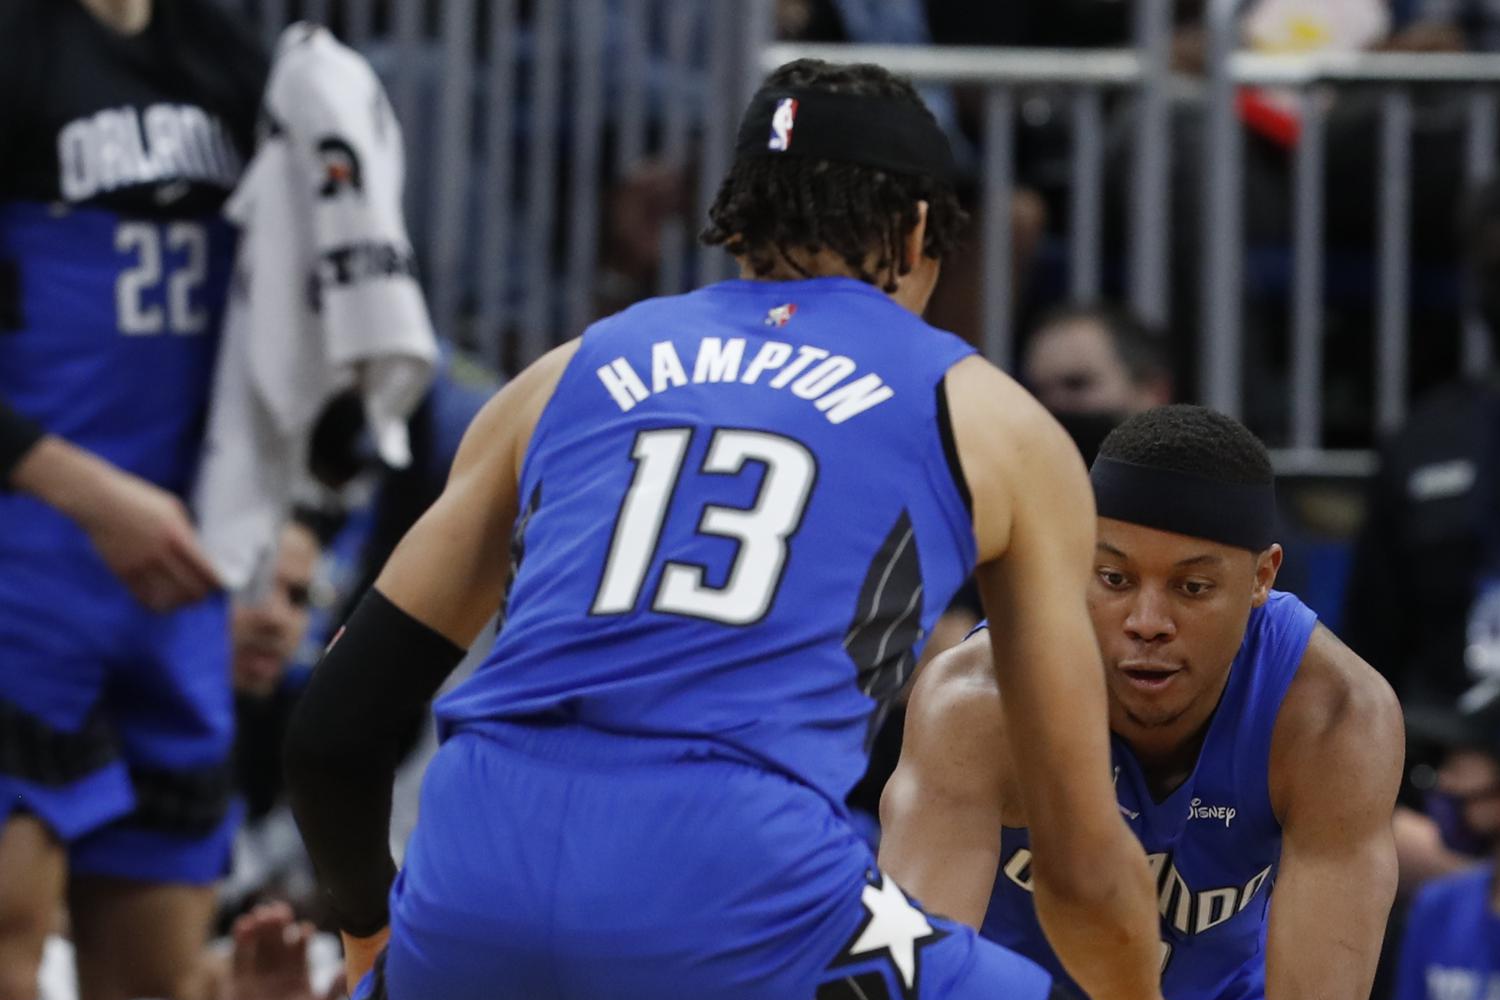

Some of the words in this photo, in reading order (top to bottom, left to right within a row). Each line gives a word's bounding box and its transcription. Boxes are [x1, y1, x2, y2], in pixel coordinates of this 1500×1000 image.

[115, 217, 208, 335] 22
[596, 336, 895, 424] HAMPTON
[588, 426, 820, 626] 13
